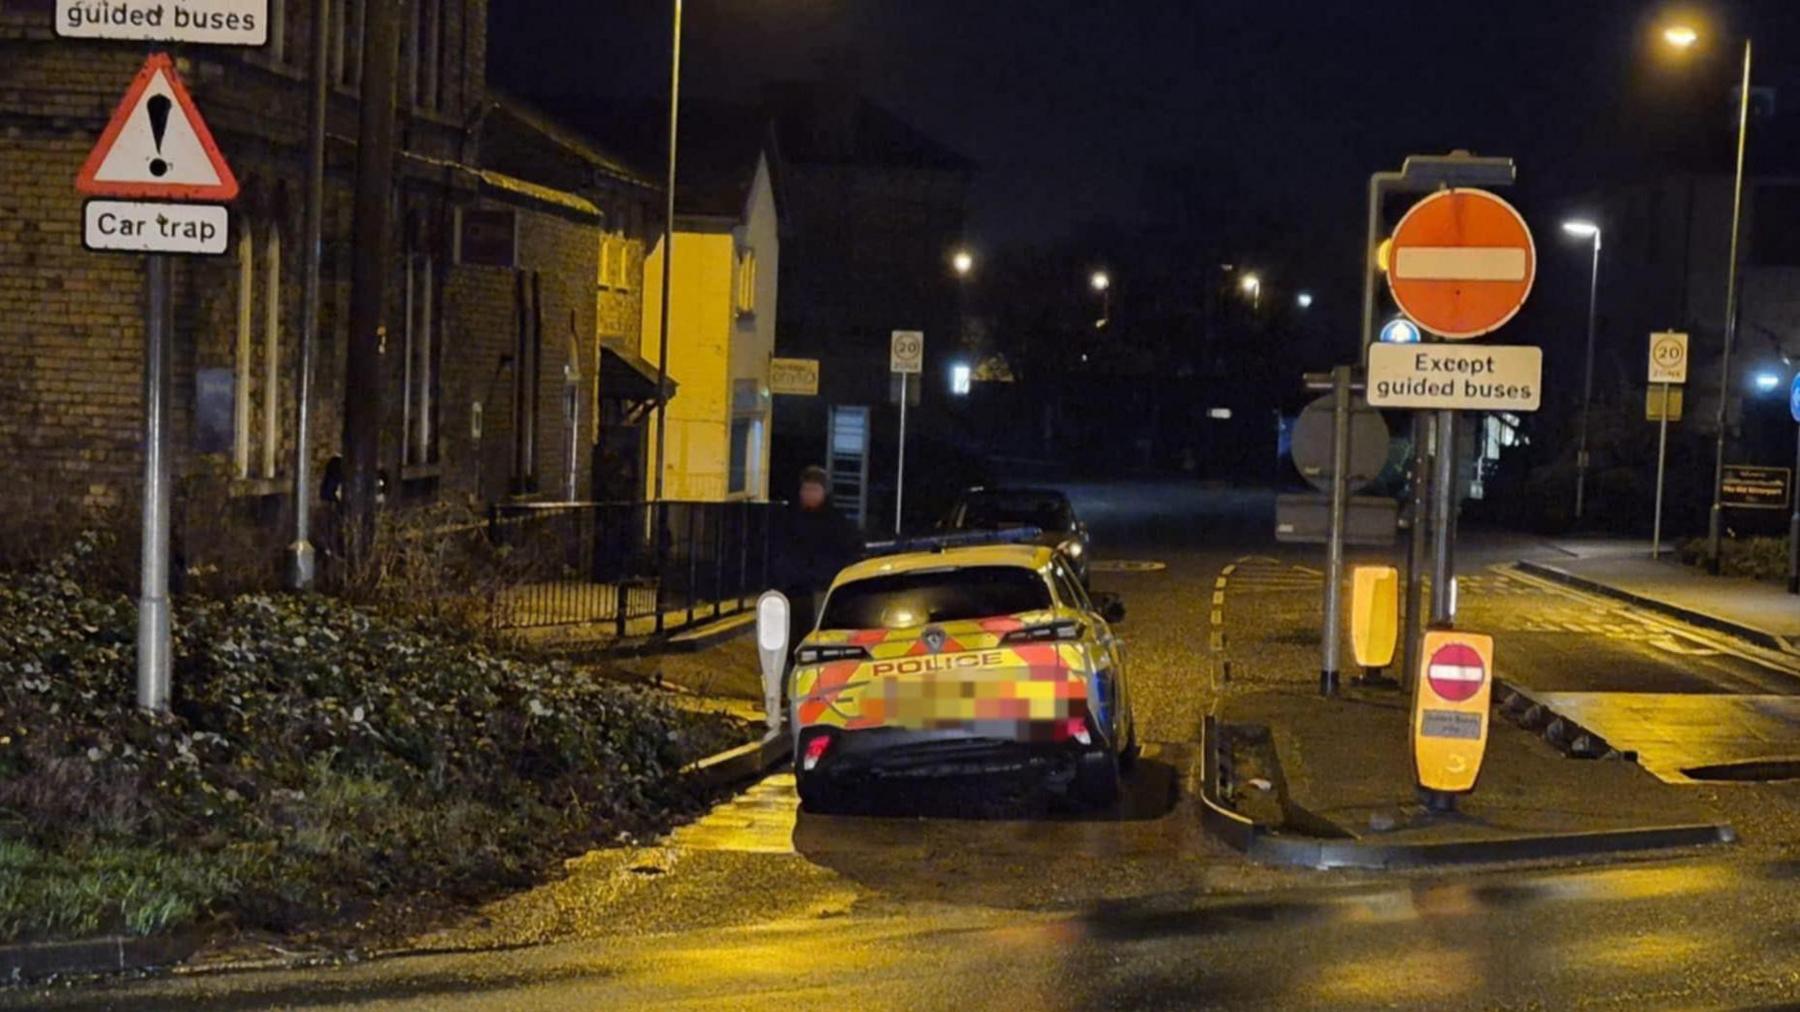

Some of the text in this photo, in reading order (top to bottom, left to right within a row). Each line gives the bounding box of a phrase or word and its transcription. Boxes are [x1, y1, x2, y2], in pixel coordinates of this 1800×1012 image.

[67, 1, 256, 31] guided buses
[98, 211, 216, 243] Car trap
[898, 341, 917, 353] 20
[1659, 346, 1680, 359] 20
[1415, 353, 1495, 376] Except
[1377, 377, 1532, 399] guided buses
[872, 652, 1003, 676] POLICE
